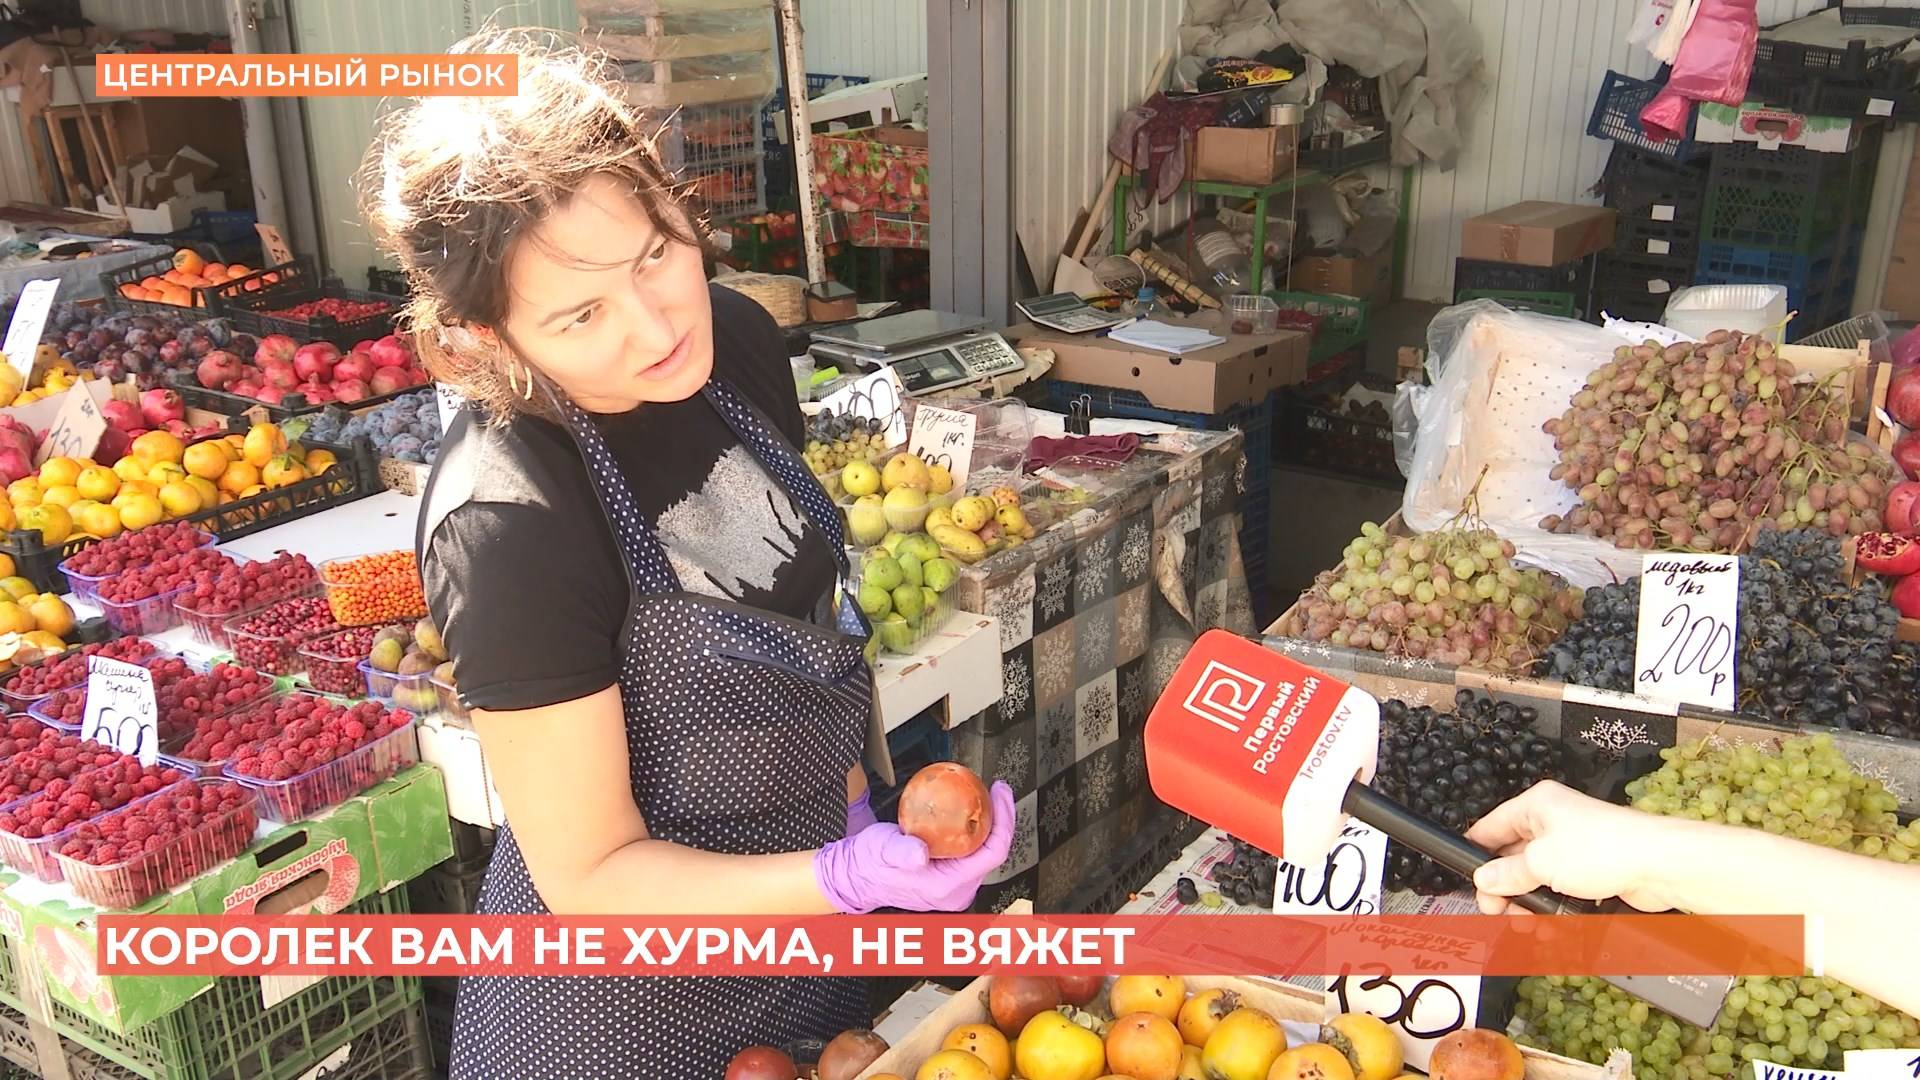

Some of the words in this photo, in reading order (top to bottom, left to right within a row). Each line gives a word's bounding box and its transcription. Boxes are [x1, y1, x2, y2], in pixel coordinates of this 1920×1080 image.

[1645, 560, 1733, 586] медовый
[1639, 603, 1732, 683] 200
[1243, 681, 1296, 753] Первый
[1252, 676, 1321, 775] Ростовский
[1300, 705, 1352, 780] 1rostov.tv
[225, 874, 271, 908] ягода
[270, 838, 347, 886] Кубанская
[1327, 962, 1466, 1039] 130
